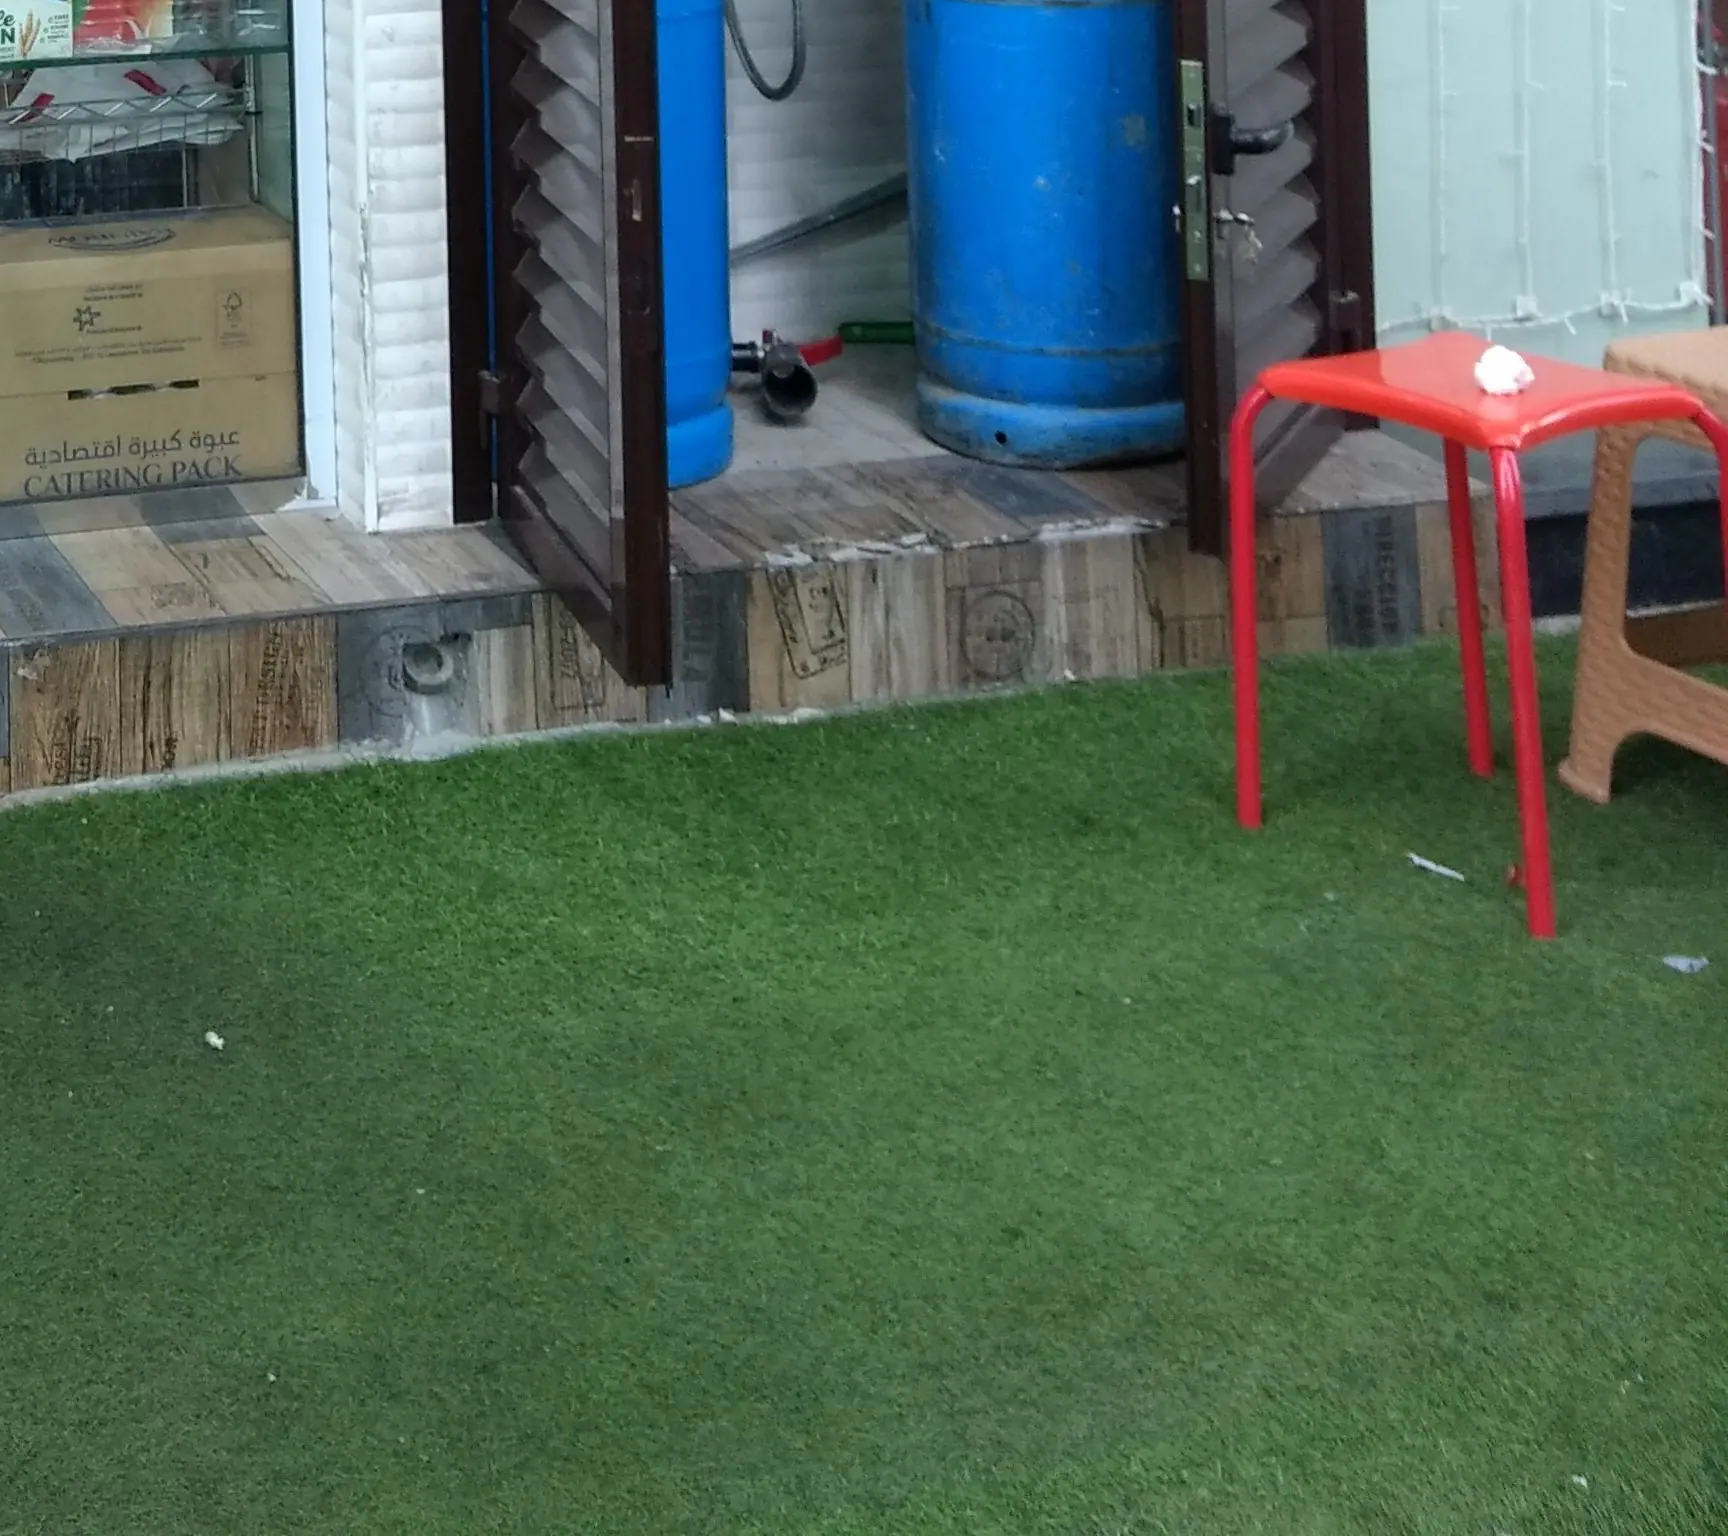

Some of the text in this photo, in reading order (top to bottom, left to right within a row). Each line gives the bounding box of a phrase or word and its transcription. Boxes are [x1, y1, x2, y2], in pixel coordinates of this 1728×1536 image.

[24, 429, 241, 469] عبوة كبيرة اقتصادية
[23, 452, 243, 500] CATERING PACK
